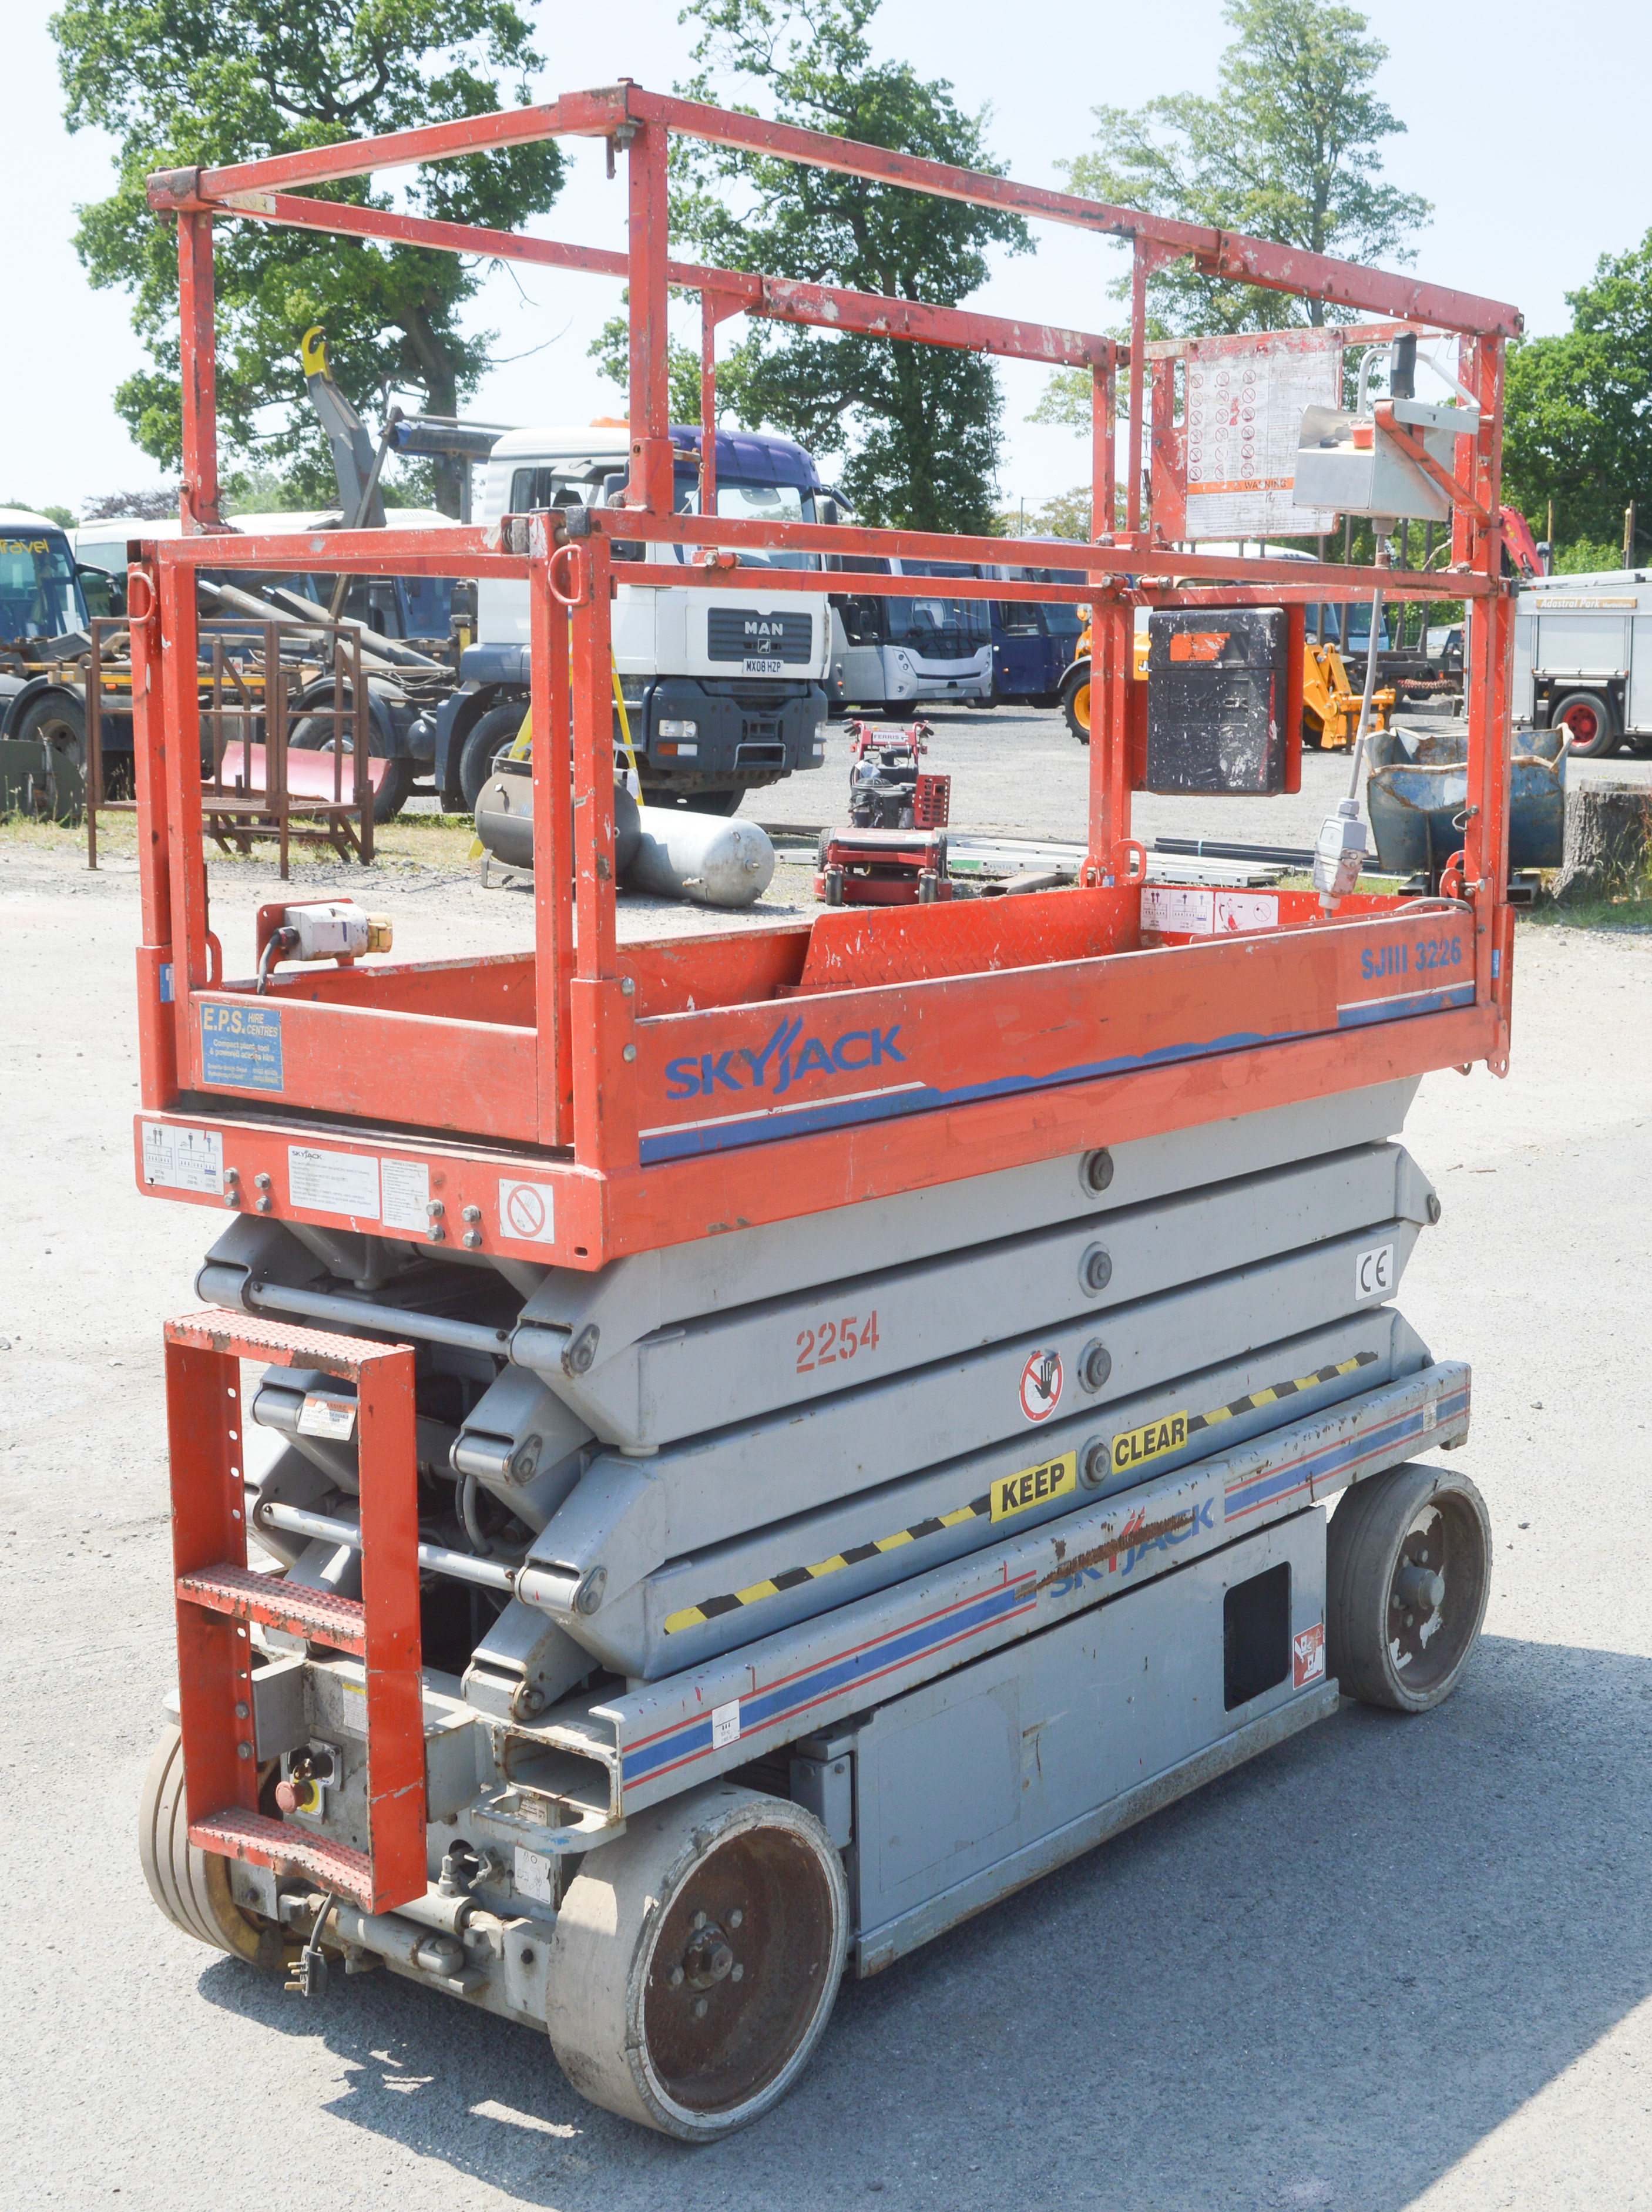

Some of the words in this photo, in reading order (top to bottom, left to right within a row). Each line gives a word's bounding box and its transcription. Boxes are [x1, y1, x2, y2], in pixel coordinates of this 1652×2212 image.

[1541, 598, 1577, 608] Adastral
[1580, 598, 1601, 608] Park
[744, 621, 783, 636] MAN
[746, 660, 765, 672] MX08
[767, 662, 781, 673] HZP
[1415, 936, 1462, 971] 3226
[203, 1007, 246, 1034] E.P.S.
[247, 1024, 278, 1038] CENTRES
[248, 1012, 264, 1023] HIRE
[664, 1015, 907, 1100] SKYJACK
[292, 1150, 323, 1160] SKYJACK
[1361, 1250, 1387, 1293] CE
[797, 1310, 879, 1374] 2254
[1115, 1418, 1184, 1466] CLEAR
[1002, 1462, 1065, 1513] KEEP
